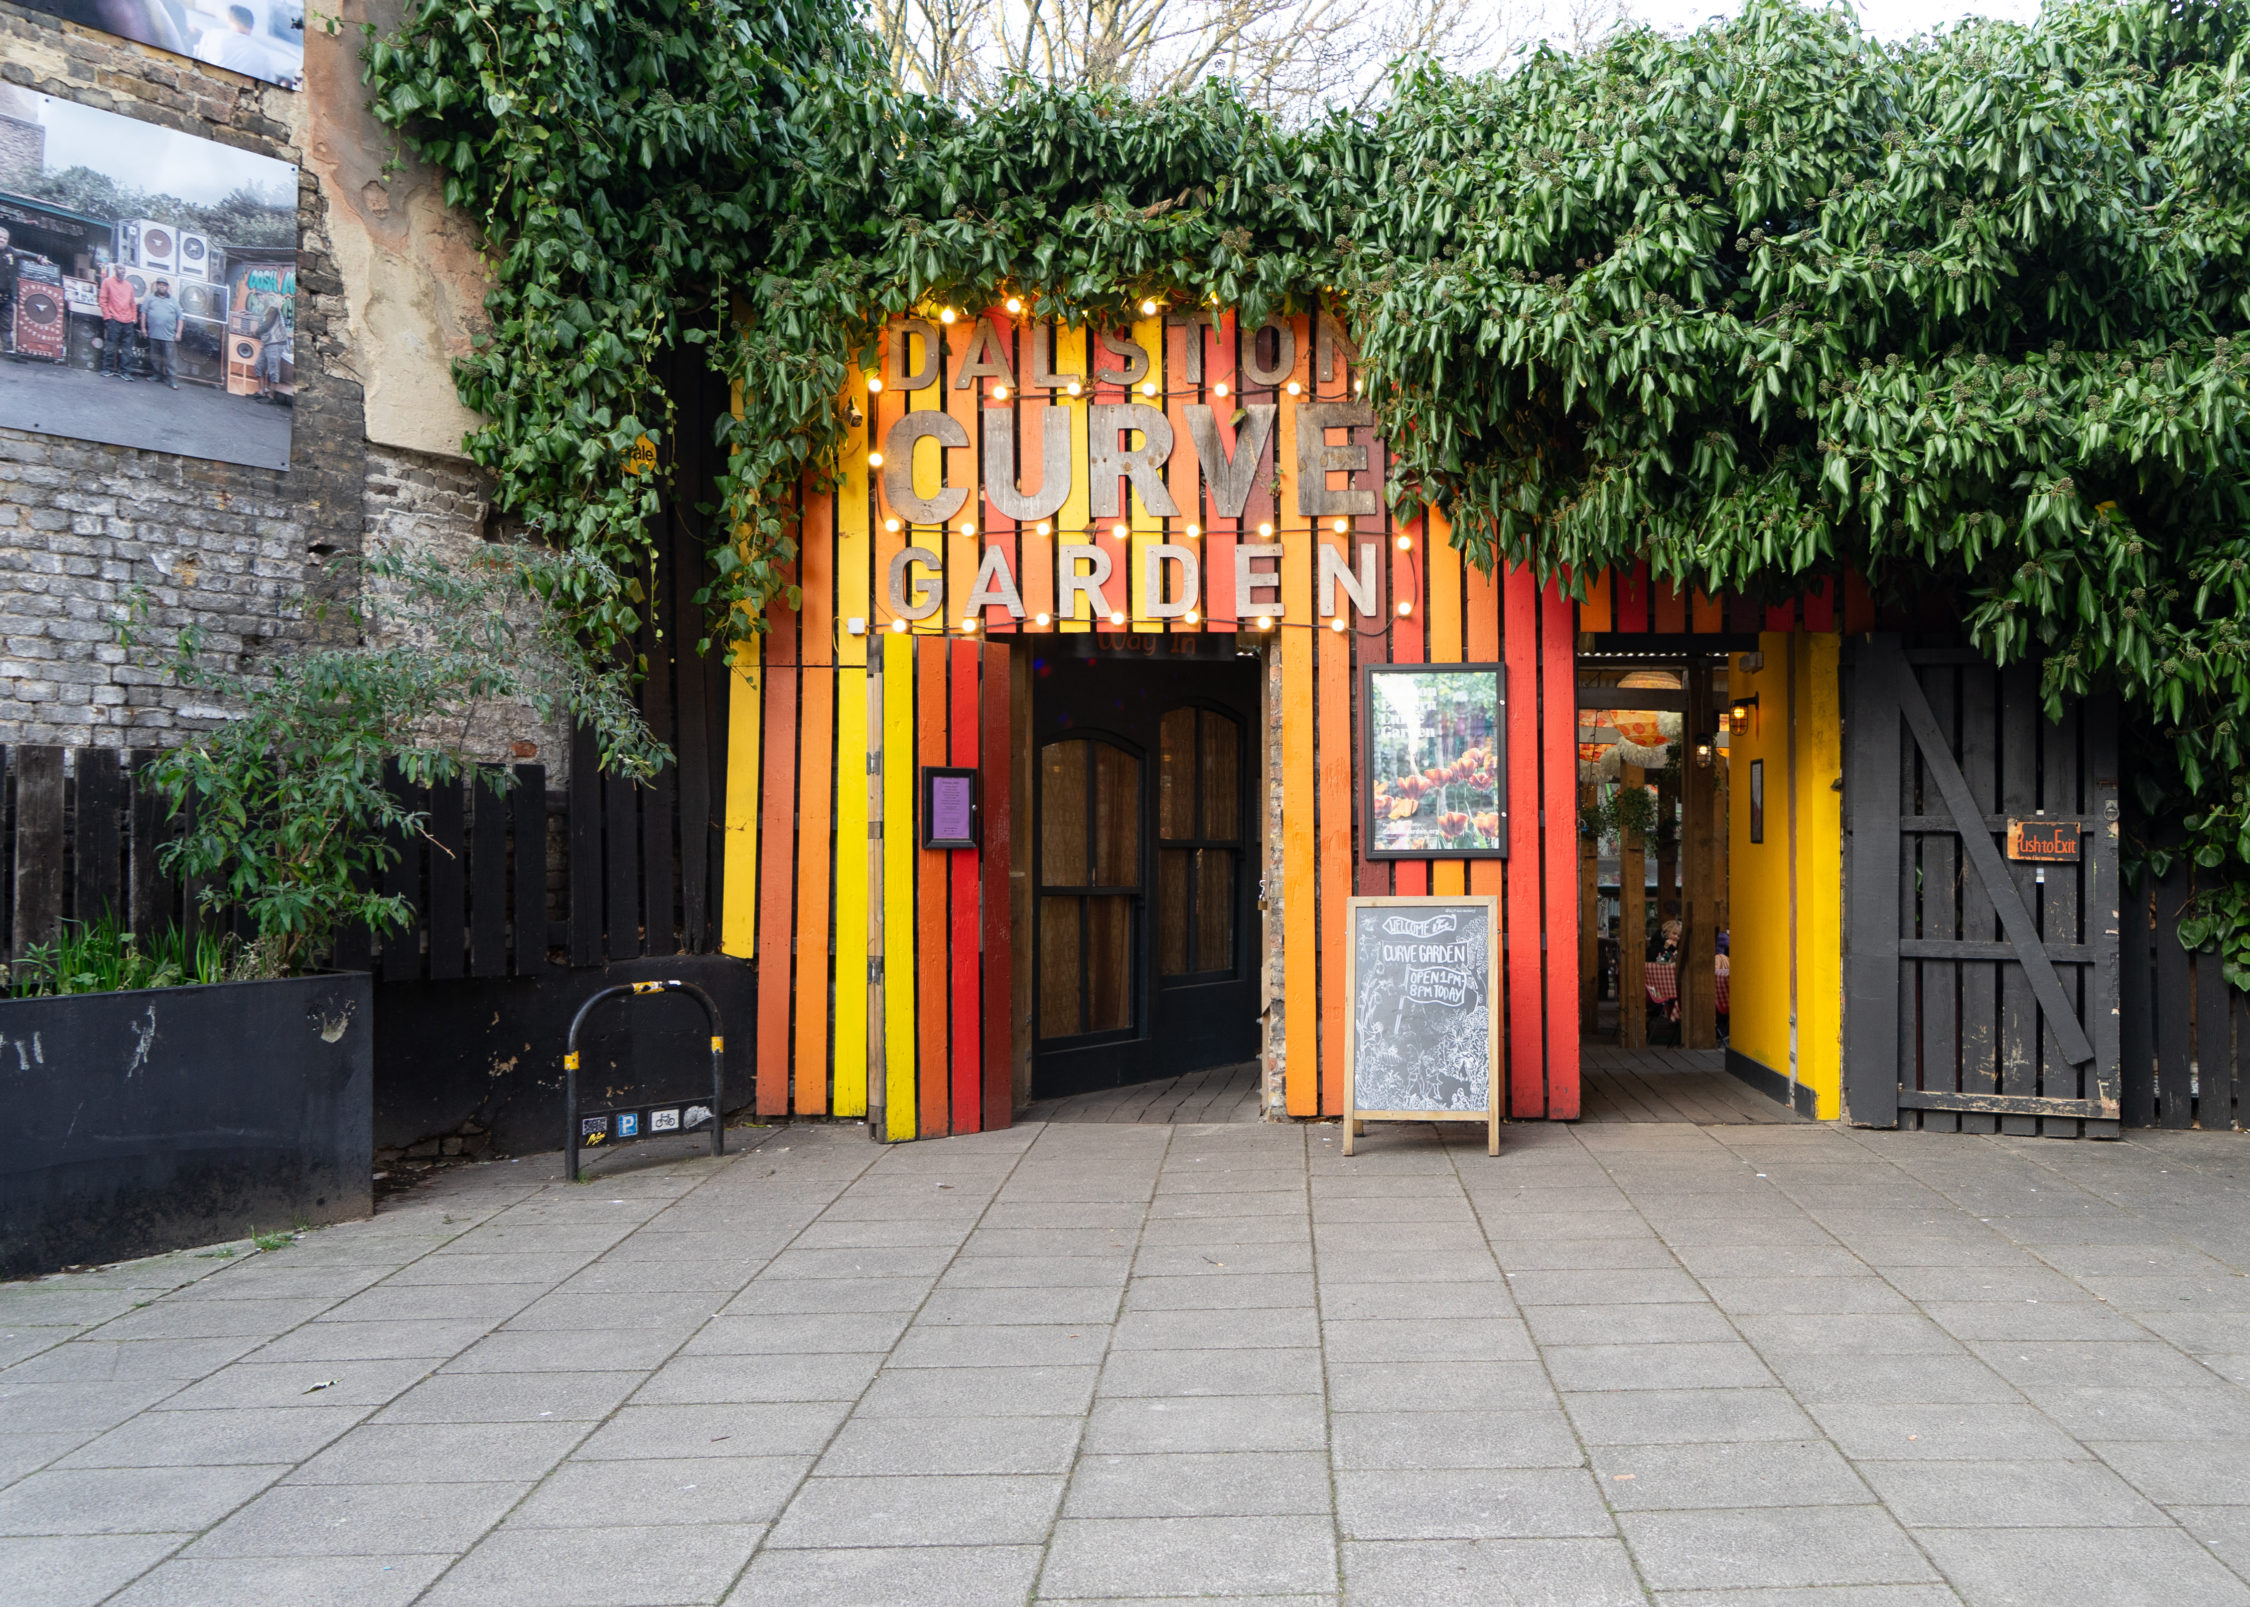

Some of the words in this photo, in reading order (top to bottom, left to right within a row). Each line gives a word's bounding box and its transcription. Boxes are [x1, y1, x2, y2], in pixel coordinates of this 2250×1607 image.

[883, 402, 1377, 525] CURVE
[888, 543, 1377, 621] GARDEN
[1098, 632, 1157, 656] Way
[1170, 632, 1196, 655] In
[1381, 726, 1437, 738] Garen
[2017, 831, 2041, 853] Push
[2042, 839, 2054, 853] to
[2054, 829, 2077, 854] Exit
[1388, 919, 1430, 935] WELCOME
[1384, 945, 1417, 963] CURVE
[1419, 945, 1465, 963] GARDEN
[1410, 971, 1439, 984] OPEN
[1410, 985, 1433, 998] 8PM
[1433, 985, 1463, 1003] TODAY
[622, 1116, 634, 1134] P
